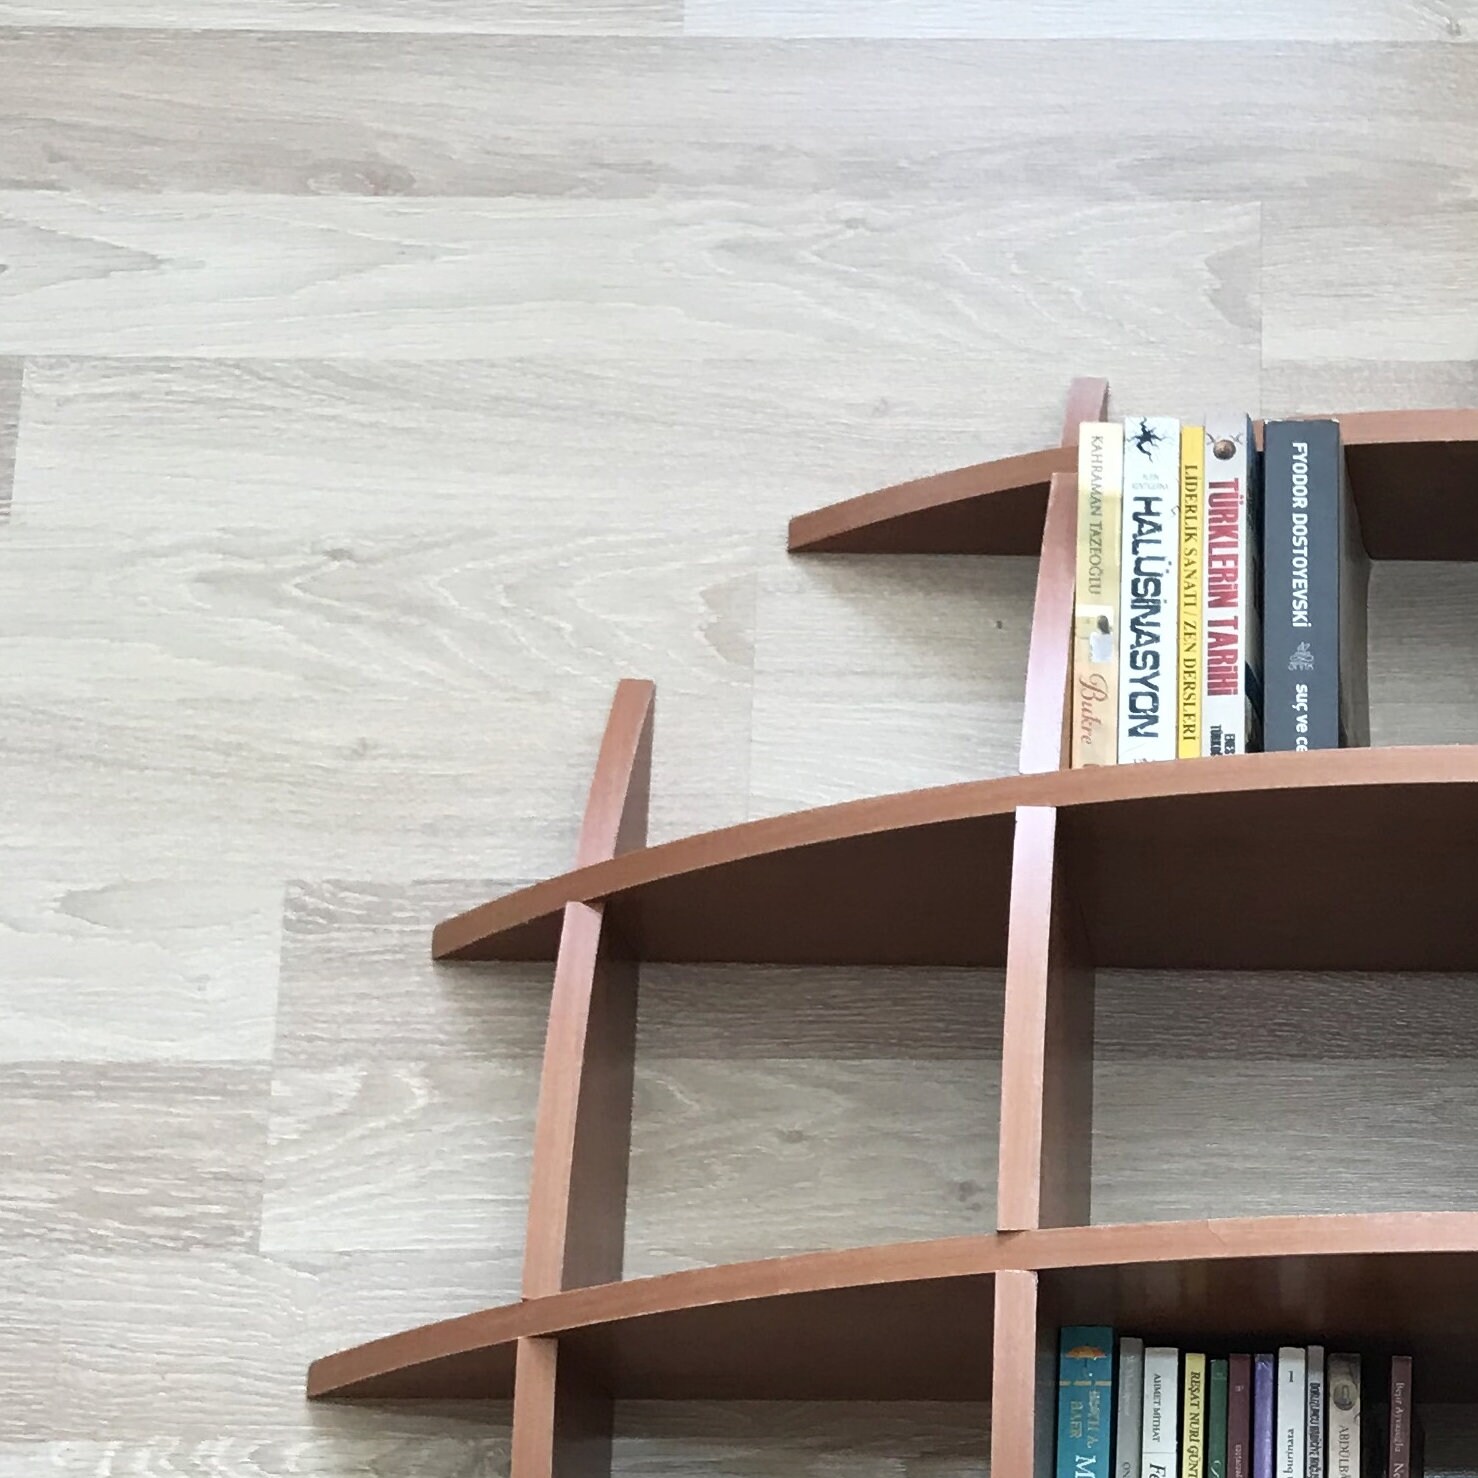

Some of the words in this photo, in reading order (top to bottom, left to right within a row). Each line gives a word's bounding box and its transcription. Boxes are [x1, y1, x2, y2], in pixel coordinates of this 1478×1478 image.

[1090, 435, 1104, 517] KAHRAMAN
[1183, 464, 1199, 542] LİDERLİK
[1292, 442, 1308, 508] FYODOR
[1087, 519, 1104, 596] TAZEOĞLU
[1183, 546, 1198, 608] SANATI
[1206, 477, 1245, 609] TÜRKLERİN
[1292, 513, 1312, 628] DOSTOYEVSKİ
[1128, 495, 1173, 738] HALÜSİNASYON
[1183, 621, 1197, 653] ZEN
[1206, 616, 1239, 697] TARİHİ
[1078, 673, 1109, 745] Bukre
[1182, 657, 1197, 741] DERSLERİ
[1291, 683, 1308, 712] suç
[1296, 714, 1308, 733] ve
[1152, 1373, 1162, 1406] AHMET
[1187, 1371, 1201, 1410] REŞAT
[1188, 1412, 1201, 1443] NURİ
[1282, 1428, 1294, 1475] burinata
